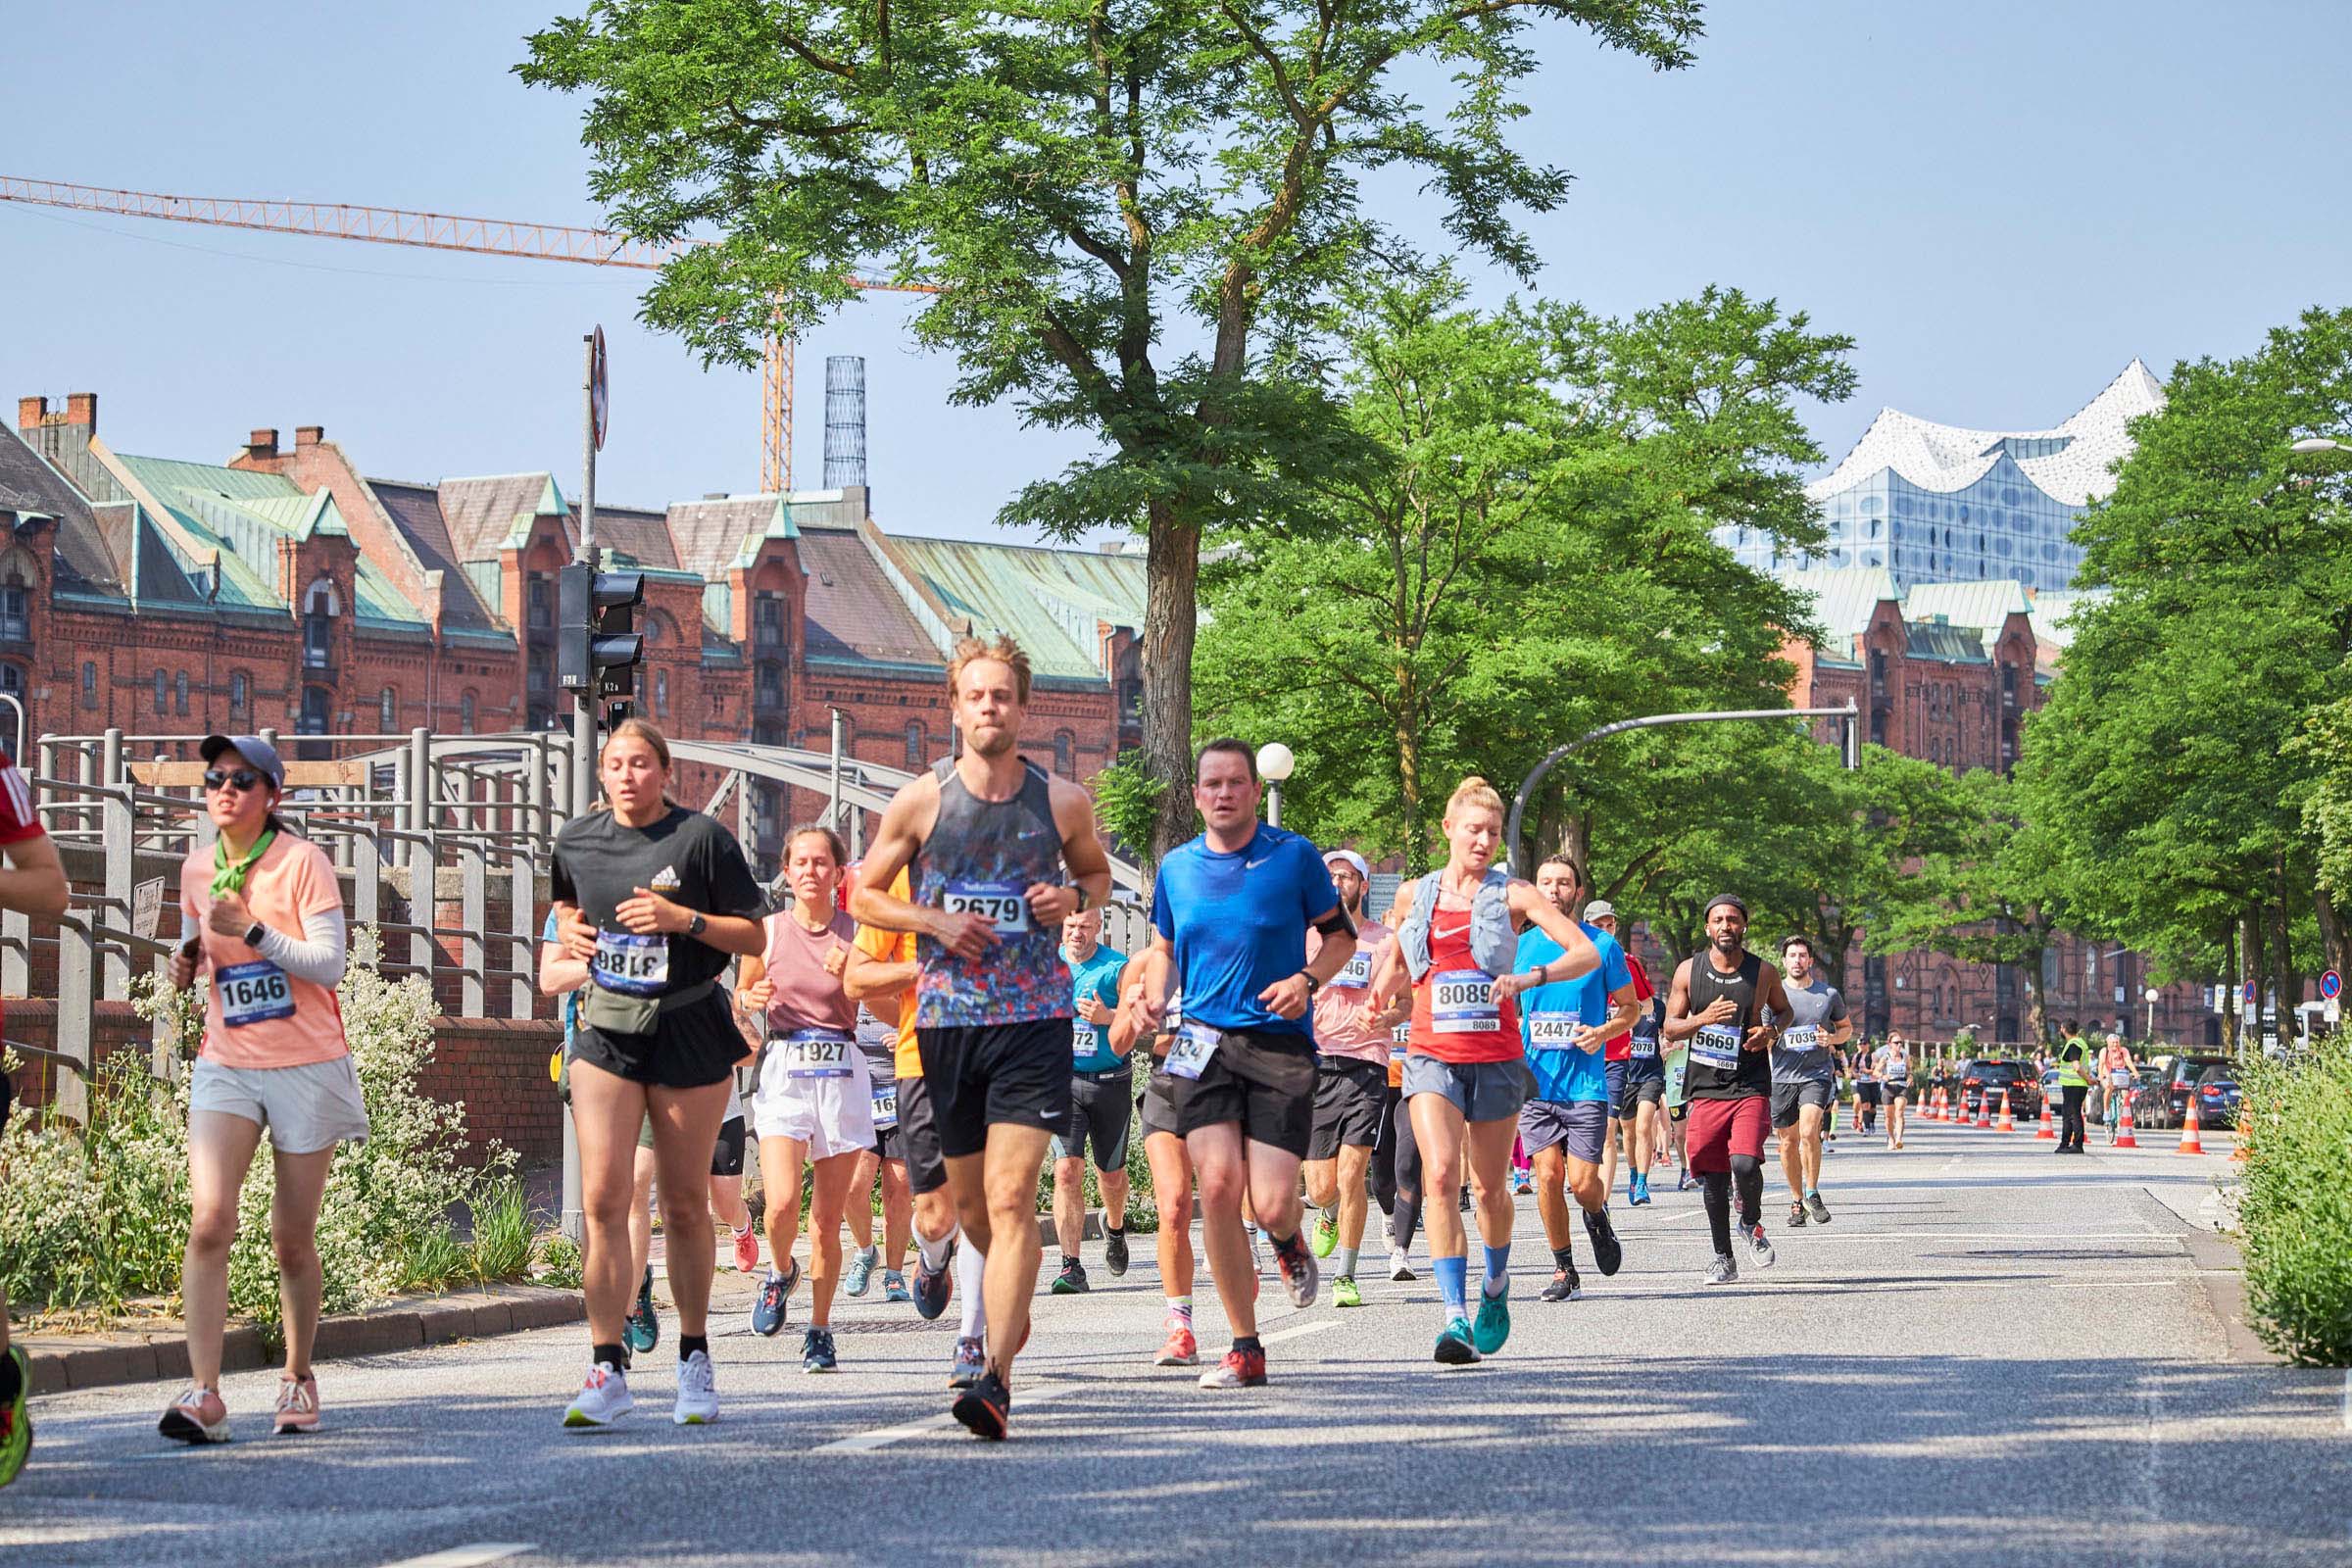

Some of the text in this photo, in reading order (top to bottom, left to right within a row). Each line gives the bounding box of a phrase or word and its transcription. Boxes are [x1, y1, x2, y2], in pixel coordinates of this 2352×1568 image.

[605, 682, 619, 691] K2a
[953, 898, 1019, 922] 2679
[1345, 960, 1365, 976] 46
[222, 975, 286, 1006] 1646
[1440, 984, 1491, 1004] 8089
[1473, 1020, 1496, 1030] 8089
[1534, 1022, 1574, 1037] 2447
[1074, 1032, 1094, 1045] 72
[1695, 1032, 1735, 1051] 5669
[1788, 1032, 1817, 1044] 7039
[796, 1042, 845, 1061] 1927
[1631, 1042, 1653, 1053] 2078
[1716, 1059, 1735, 1069] 5669
